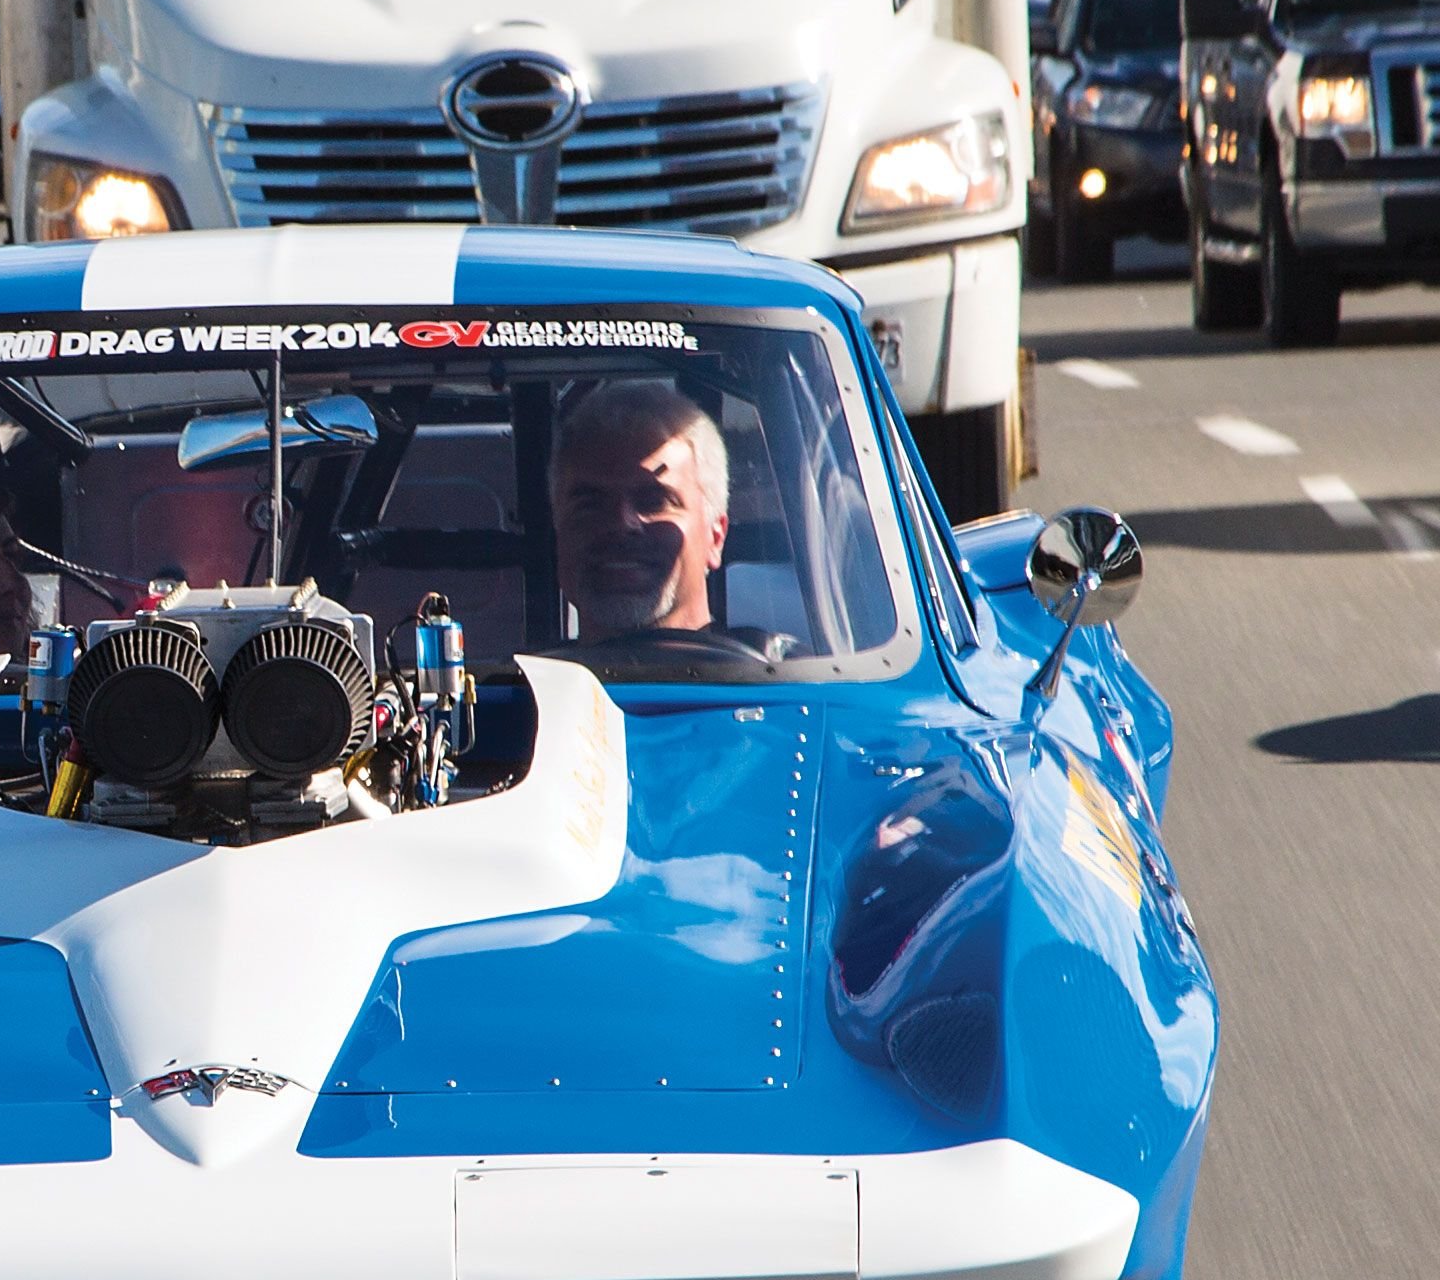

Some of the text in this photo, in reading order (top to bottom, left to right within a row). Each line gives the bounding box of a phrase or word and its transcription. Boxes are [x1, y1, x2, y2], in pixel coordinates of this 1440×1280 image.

[496, 320, 685, 338] GEAR VENDORS
[59, 327, 175, 357] DRAG
